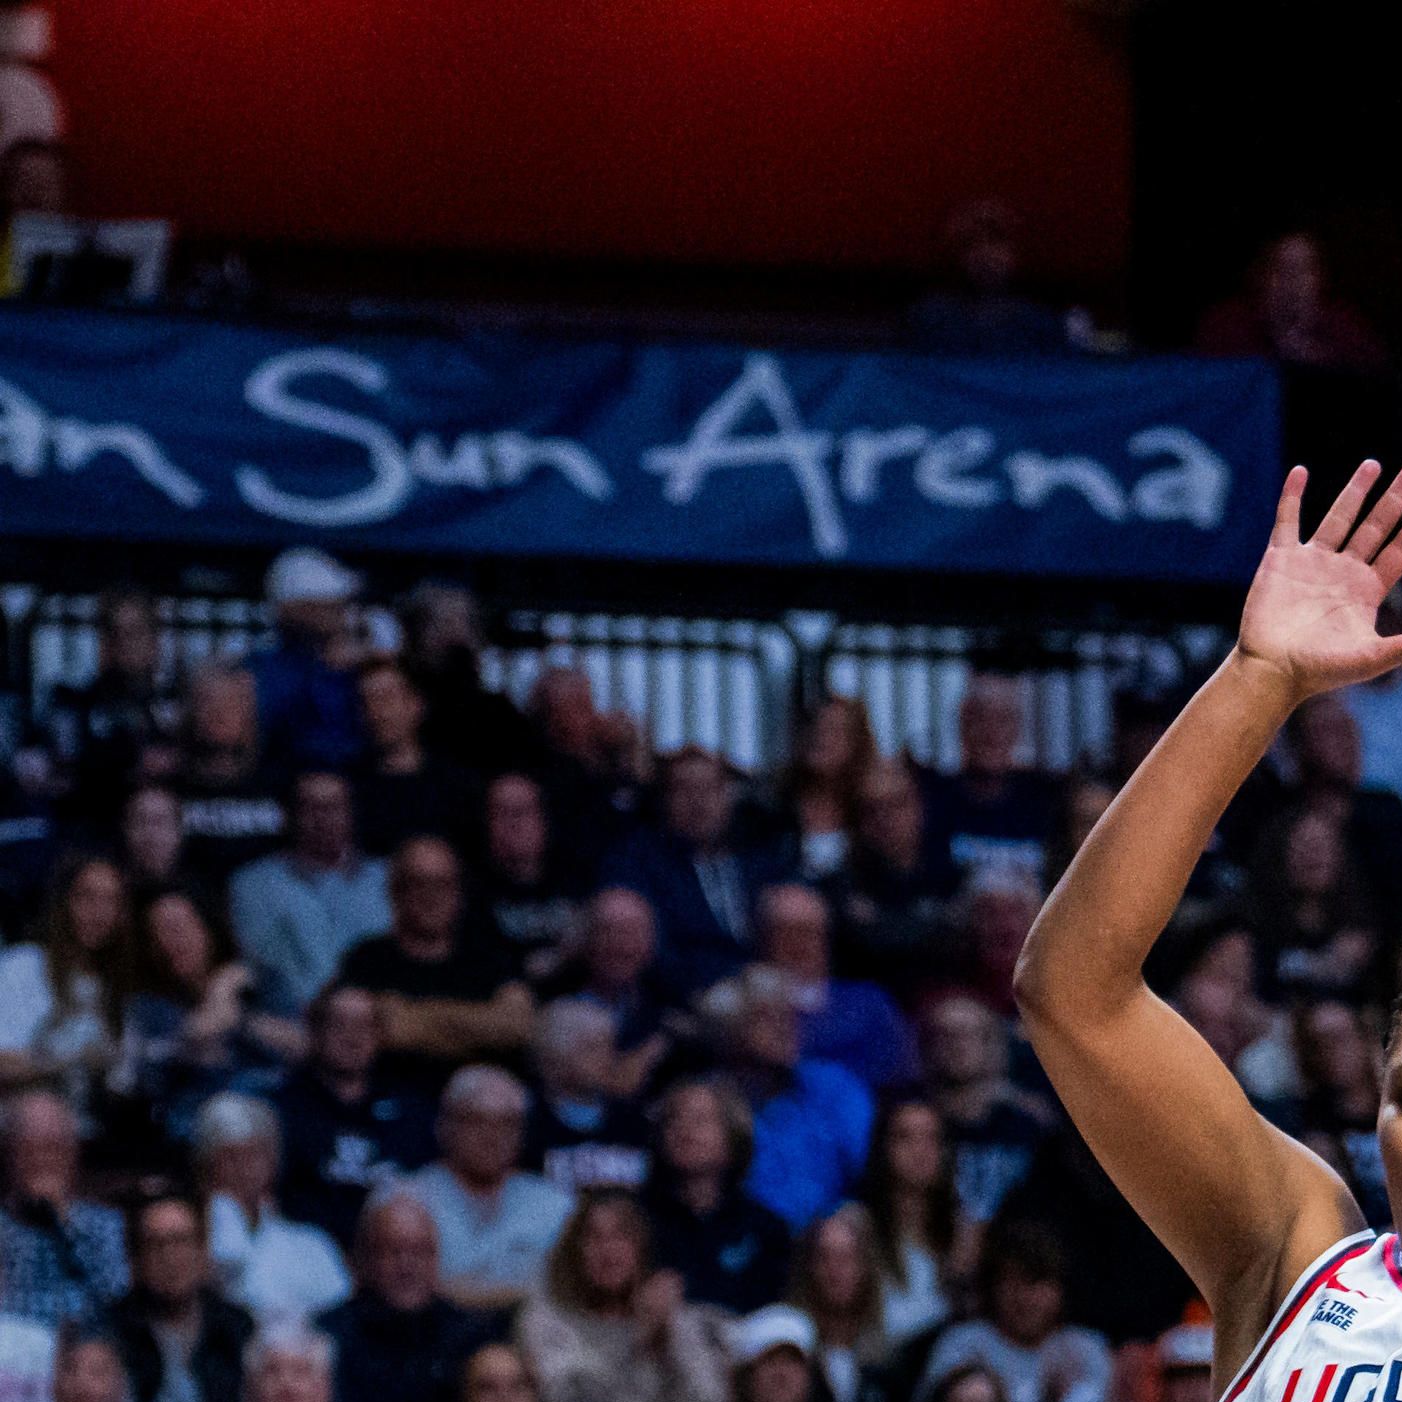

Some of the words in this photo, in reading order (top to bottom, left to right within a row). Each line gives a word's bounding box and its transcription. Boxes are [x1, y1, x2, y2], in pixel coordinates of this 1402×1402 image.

[233, 346, 612, 527] Sun
[642, 350, 1232, 560] Arena
[1328, 1299, 1359, 1320] THE
